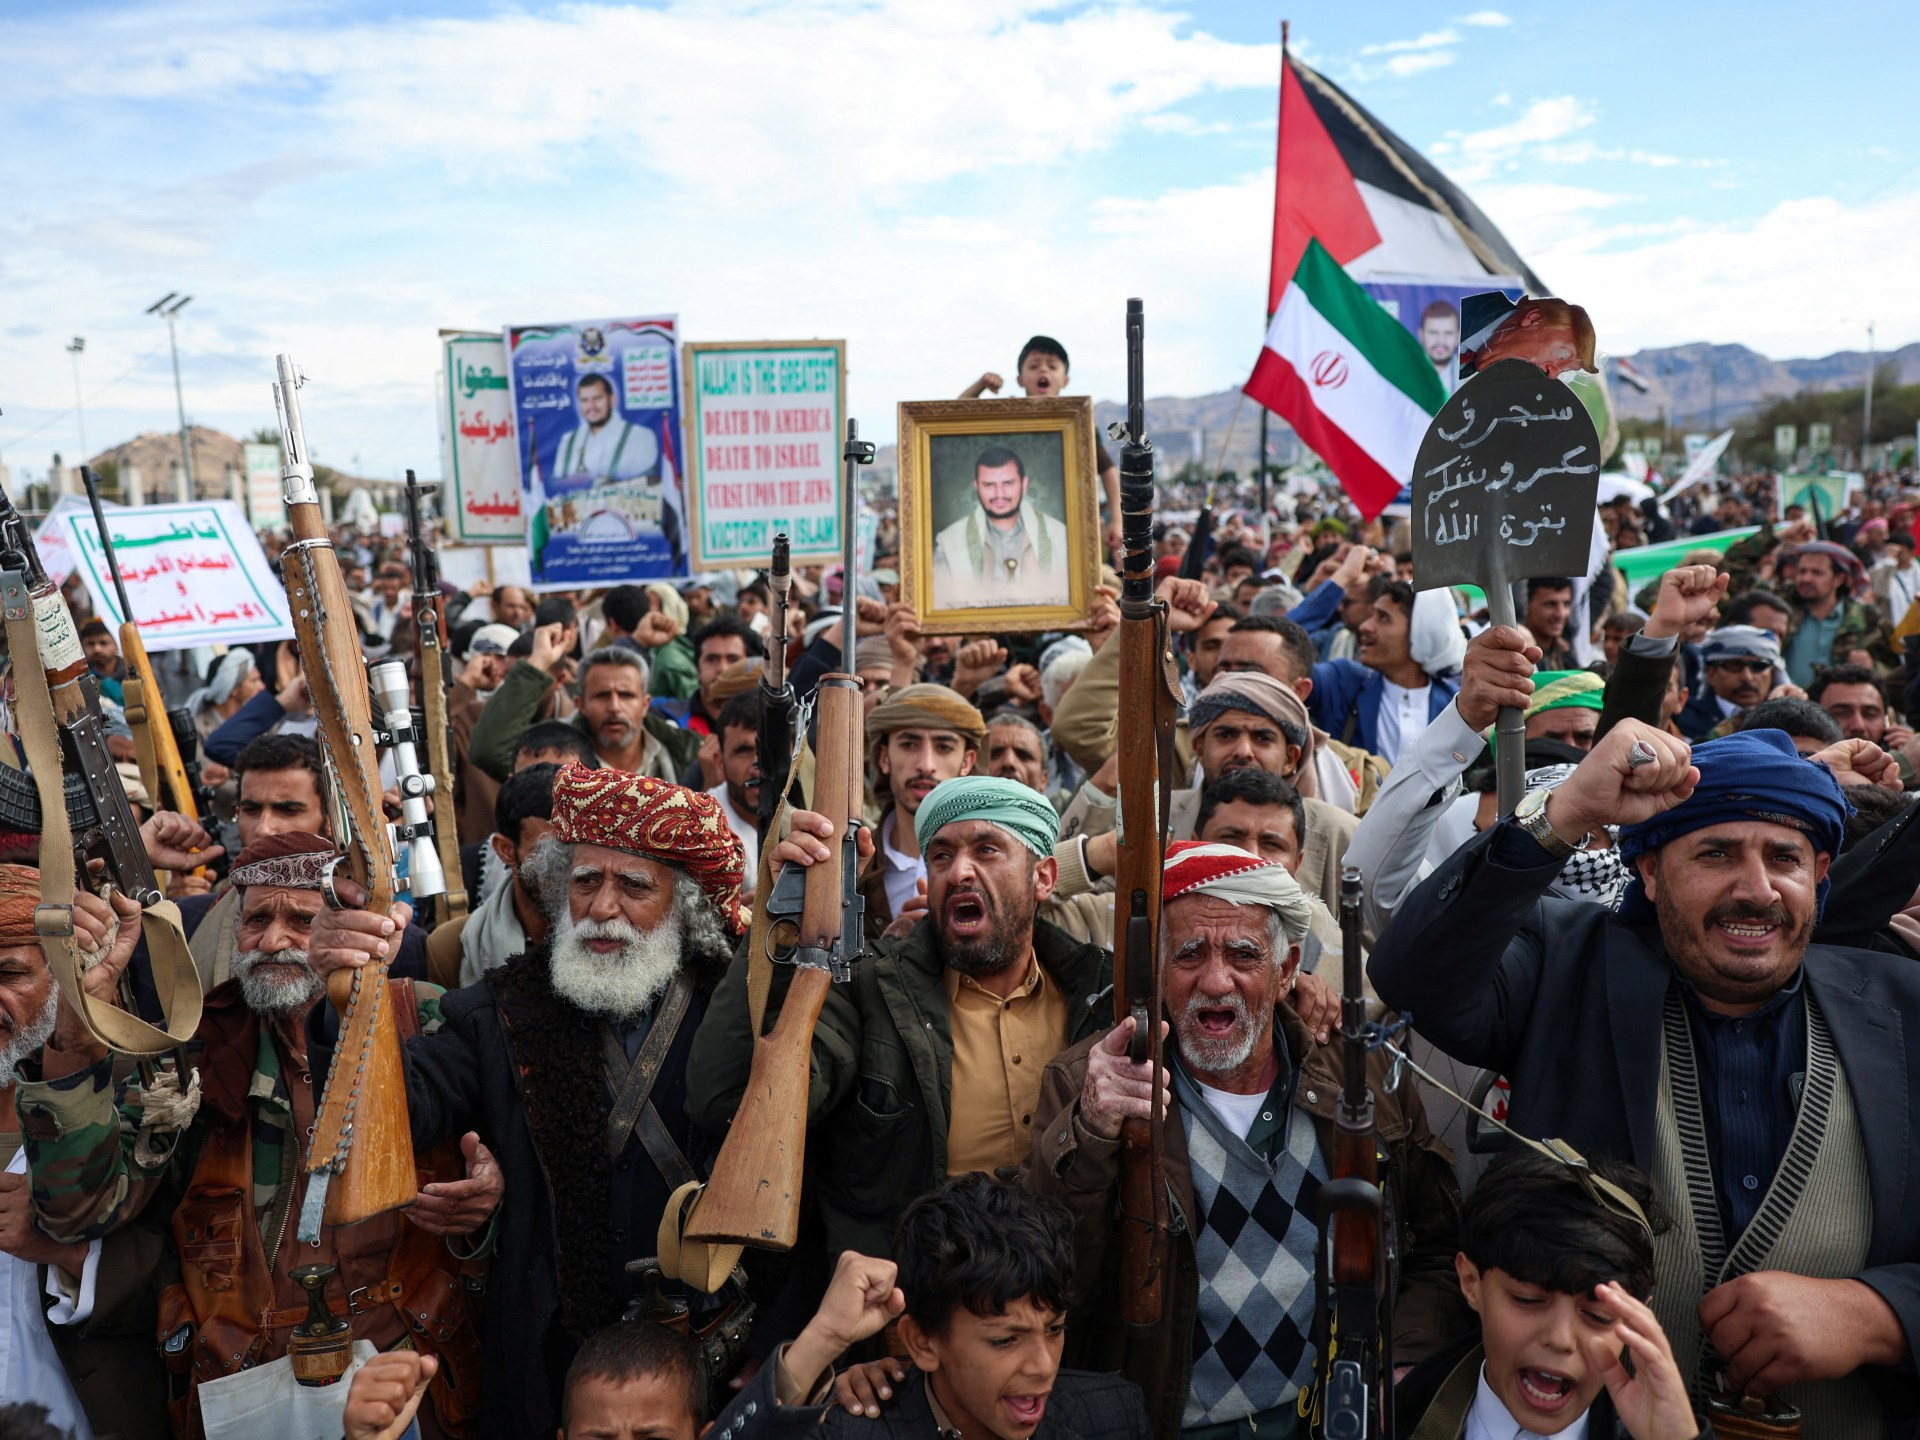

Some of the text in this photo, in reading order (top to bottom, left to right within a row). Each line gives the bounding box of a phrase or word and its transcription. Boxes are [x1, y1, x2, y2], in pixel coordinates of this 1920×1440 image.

[457, 357, 509, 398] عوا
[702, 359, 833, 395] ALLAH IS THE GREATEST
[704, 407, 832, 436] DEATH TO AMERICA
[1438, 393, 1574, 449] سنجرف
[706, 442, 821, 471] DEATH TO ISRAEL
[706, 479, 833, 509] CURSE UPON THE JEWS
[708, 516, 834, 550] VICTORY TO ISLAM
[1499, 503, 1566, 547] بقوة
[100, 554, 175, 584] الأمريكة
[134, 602, 265, 629] الإسرائيلي
